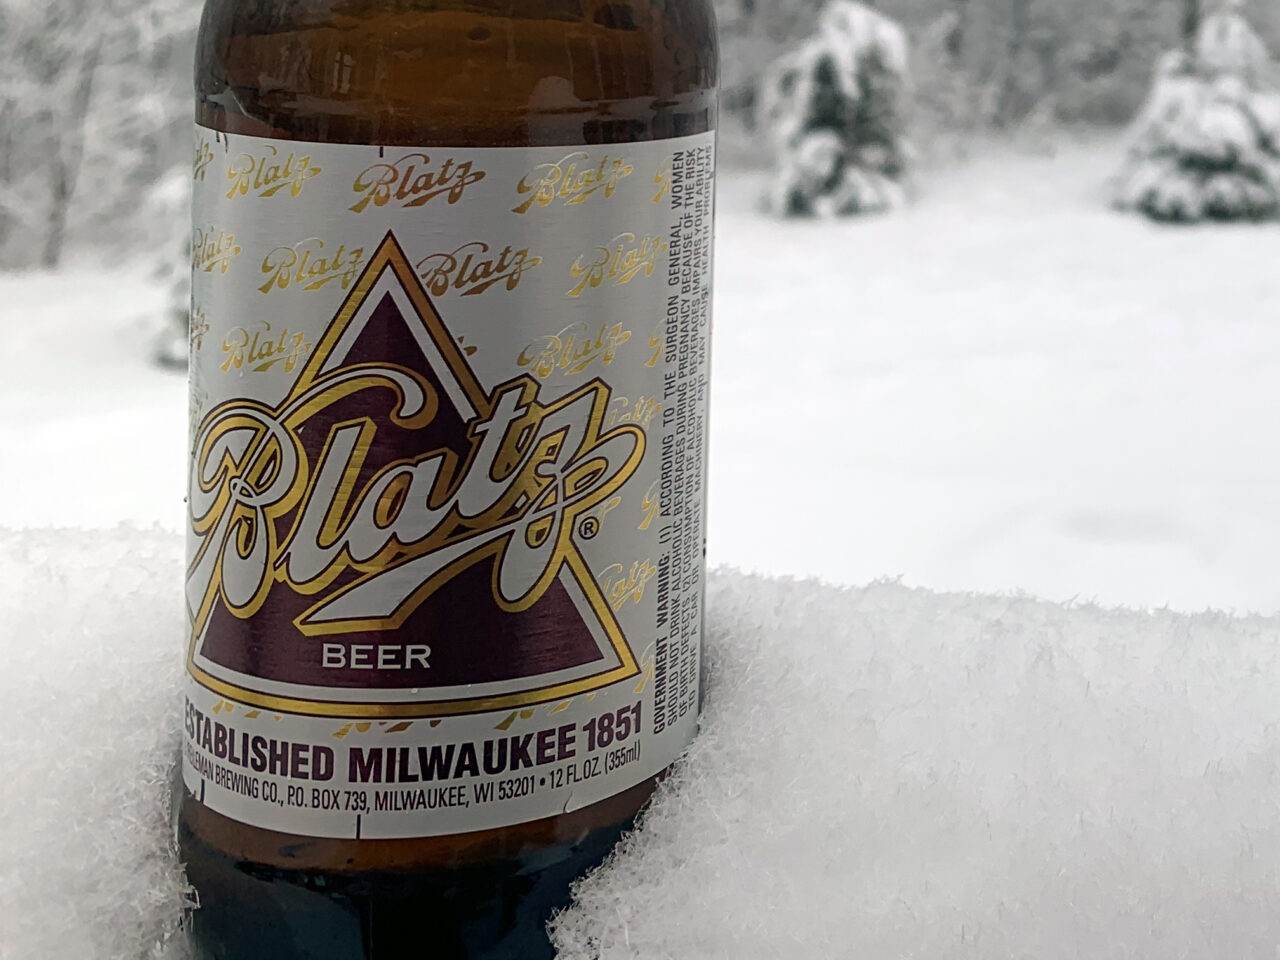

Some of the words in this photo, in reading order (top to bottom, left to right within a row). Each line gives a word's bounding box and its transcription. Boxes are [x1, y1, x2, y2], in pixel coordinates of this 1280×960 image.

[226, 145, 322, 200] Blatz
[348, 153, 487, 214] Blatz
[511, 151, 633, 215] Blatz
[671, 151, 684, 210] WOMEN
[685, 148, 696, 180] RISK
[695, 147, 705, 196] ABILITY
[683, 212, 694, 229] OF
[684, 183, 695, 209] THE
[694, 199, 704, 236] YOUR
[257, 237, 364, 295] Blatz
[415, 241, 544, 297] Blatz
[566, 232, 668, 297] Blatz
[668, 217, 683, 286] GENERAL,
[681, 231, 693, 295] BECAUSE
[692, 238, 702, 295] IMPAIRS
[220, 320, 313, 374] Blatz
[517, 321, 632, 379] Blatz
[665, 295, 679, 363] SURGEON
[678, 299, 690, 380] PREGNANCY
[689, 298, 700, 376] BEVERAGES
[663, 370, 676, 400] THE
[676, 382, 688, 436] DURING
[687, 377, 697, 450] ALCOHOLIC
[662, 407, 675, 428] TO
[660, 434, 674, 517] ACCORDING
[673, 437, 686, 517] BEVERAGES
[686, 455, 695, 471] OF
[186, 361, 647, 638] Blatz
[683, 473, 694, 574] CONSUMPTION
[658, 525, 672, 545] (1)
[671, 518, 683, 591] ALCOHOLIC
[656, 550, 671, 628] WARNING:
[682, 575, 692, 593] (2)
[670, 593, 681, 639] DRINK
[322, 642, 432, 670] BEER
[669, 641, 680, 670] NOT
[679, 656, 689, 699] BIRTH
[653, 636, 668, 735] GOVERNMENT
[667, 671, 679, 726] SHOULD
[679, 700, 688, 717] OF
[184, 694, 335, 782] ESTABLISHED
[348, 722, 577, 784] MILWAUKEE
[582, 700, 642, 752] 1851
[215, 764, 259, 799] BREWING
[262, 780, 284, 807] CO.,
[311, 790, 341, 811] BOX
[344, 790, 370, 814] 739,
[374, 785, 470, 812] MILWAUKEE,
[474, 782, 494, 804] WI
[498, 776, 536, 800] 53201
[550, 769, 563, 790] 12
[604, 739, 641, 775] (355ml)
